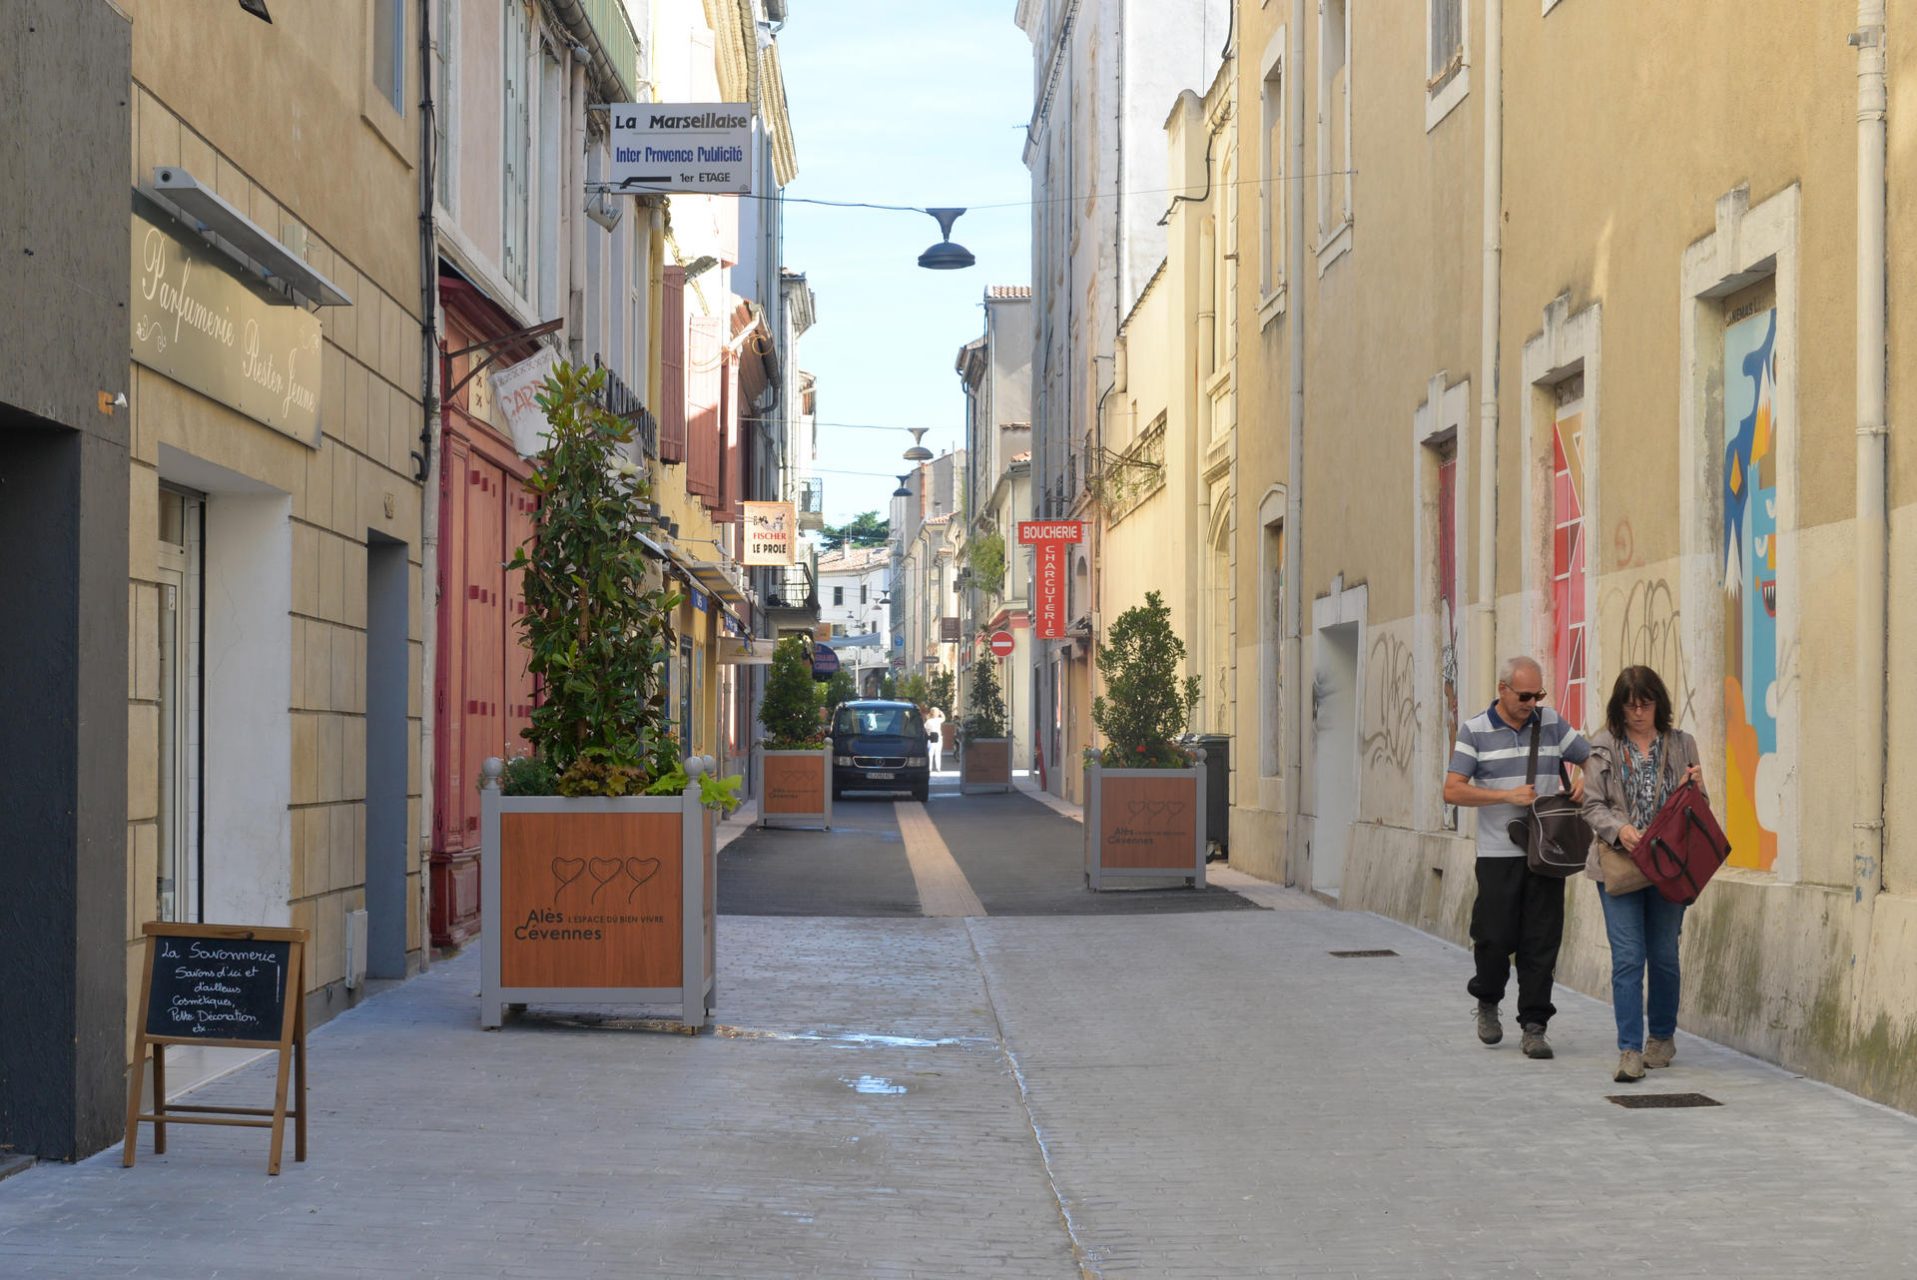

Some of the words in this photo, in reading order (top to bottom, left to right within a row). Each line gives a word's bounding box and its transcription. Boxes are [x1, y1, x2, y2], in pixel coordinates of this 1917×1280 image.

[615, 115, 637, 129] La
[649, 113, 747, 129] Marseillaise
[616, 147, 641, 163] Inter
[645, 147, 694, 163] Provence
[698, 145, 743, 163] Publicité
[679, 173, 694, 183] 1er
[699, 172, 731, 183] ETAGE
[142, 227, 235, 347] Parfumerie
[242, 318, 284, 396] Rester
[282, 348, 316, 420] Jeune
[753, 532, 787, 540] FISCHER
[1023, 526, 1078, 539] BOUCHERIE
[753, 543, 760, 553] LE
[763, 543, 786, 553] PROLE
[1044, 545, 1056, 636] CHARCUTERIE
[527, 907, 563, 924] Alès
[514, 924, 602, 941] Cévennes
[161, 942, 180, 958] La
[189, 941, 277, 963] Savonnerie
[175, 966, 215, 979] Savons
[244, 966, 259, 978] et
